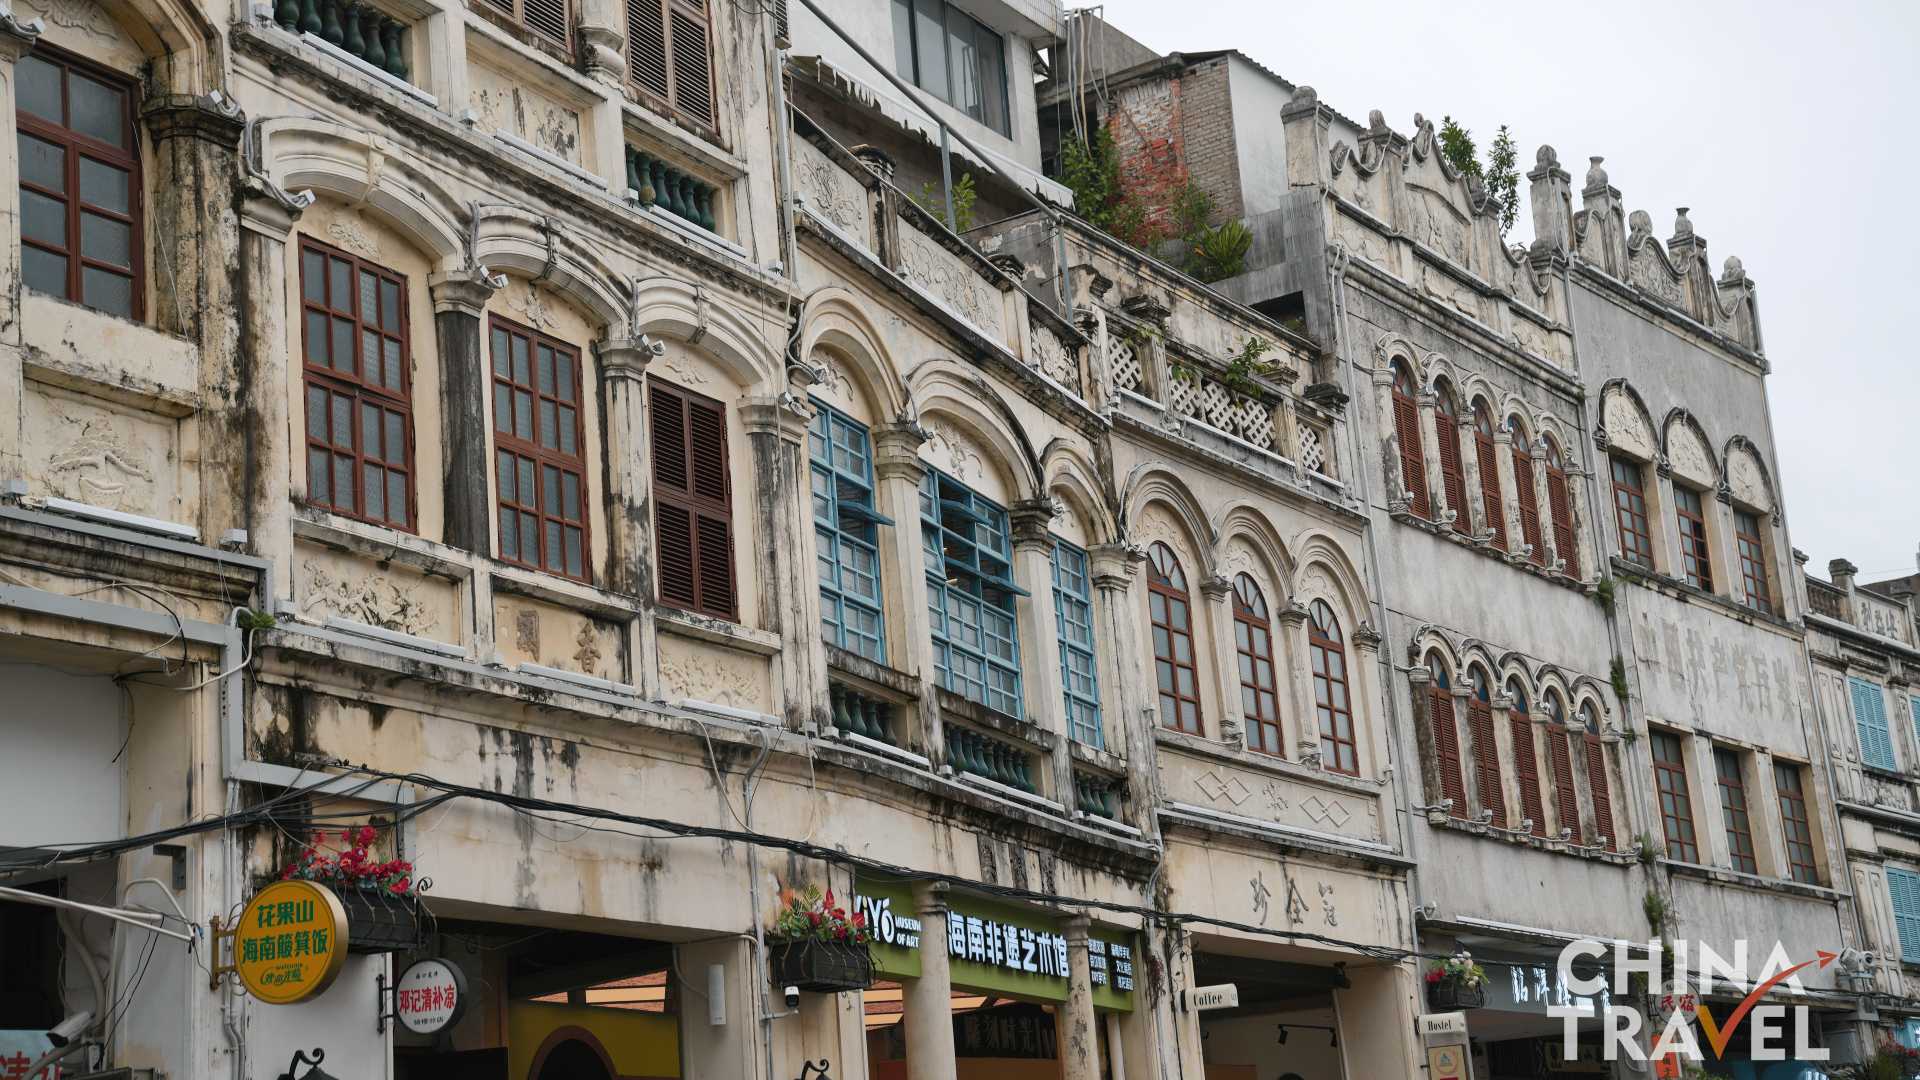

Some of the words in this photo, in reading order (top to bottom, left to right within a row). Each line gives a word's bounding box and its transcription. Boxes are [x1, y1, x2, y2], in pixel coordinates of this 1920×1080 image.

[257, 899, 314, 929] 花果山
[894, 914, 922, 932] MUSEUM
[242, 928, 328, 964] 海南簸箕饭
[896, 932, 906, 945] OF
[906, 936, 920, 948] ART
[947, 910, 1070, 978] 海南非遗艺术馆
[275, 963, 303, 971] welcome
[398, 983, 455, 1014] 邓记清补凉
[1193, 991, 1223, 1007] Coffee
[1660, 993, 1695, 1013] 民宿
[963, 1014, 1035, 1052] 雕刻时光
[1427, 1019, 1452, 1031] Hostel
